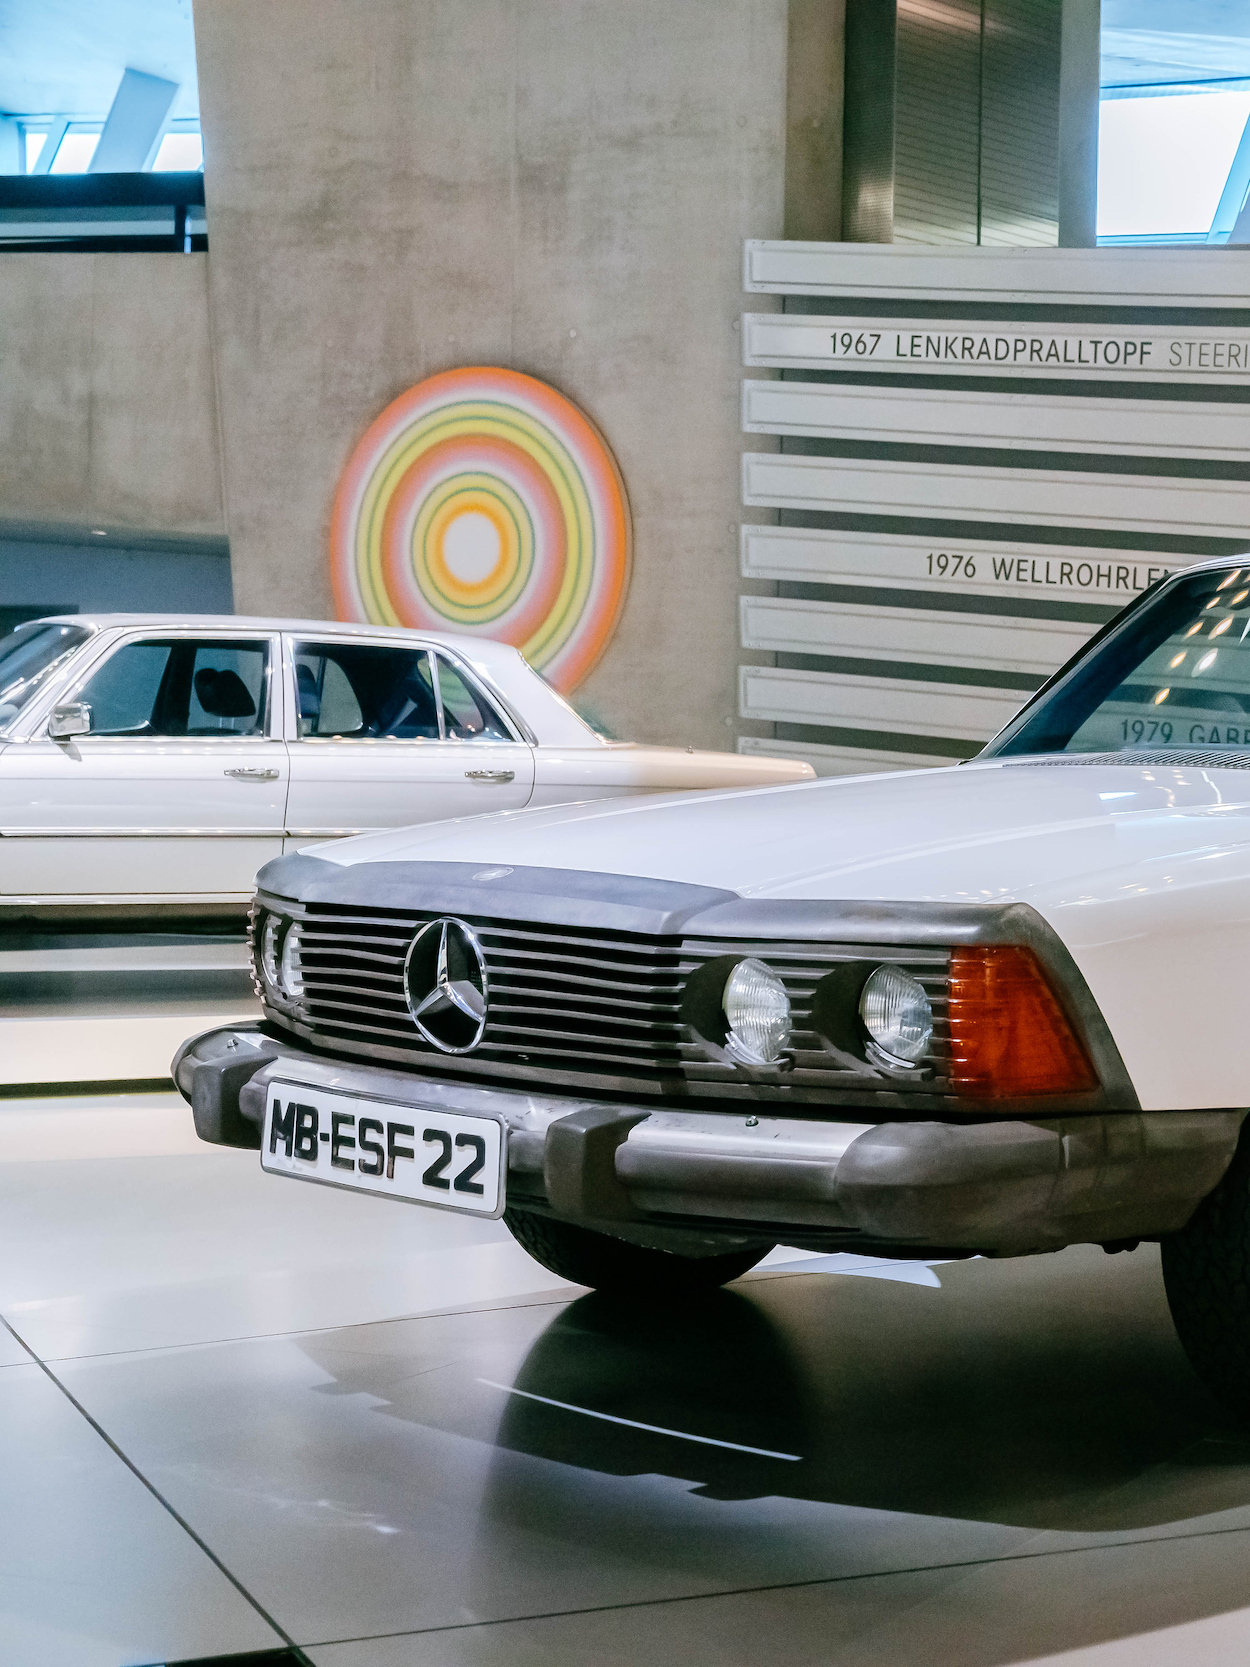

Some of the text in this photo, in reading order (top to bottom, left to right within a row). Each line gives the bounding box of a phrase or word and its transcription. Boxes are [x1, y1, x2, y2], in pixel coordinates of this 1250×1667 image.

[830, 332, 882, 356] 1967
[896, 334, 1153, 366] LENKRADPRALLTOPF
[926, 553, 1170, 591] 1976 WELLROHRLE
[1121, 718, 1173, 744] 1979
[269, 1098, 487, 1195] MB-ESF 22
